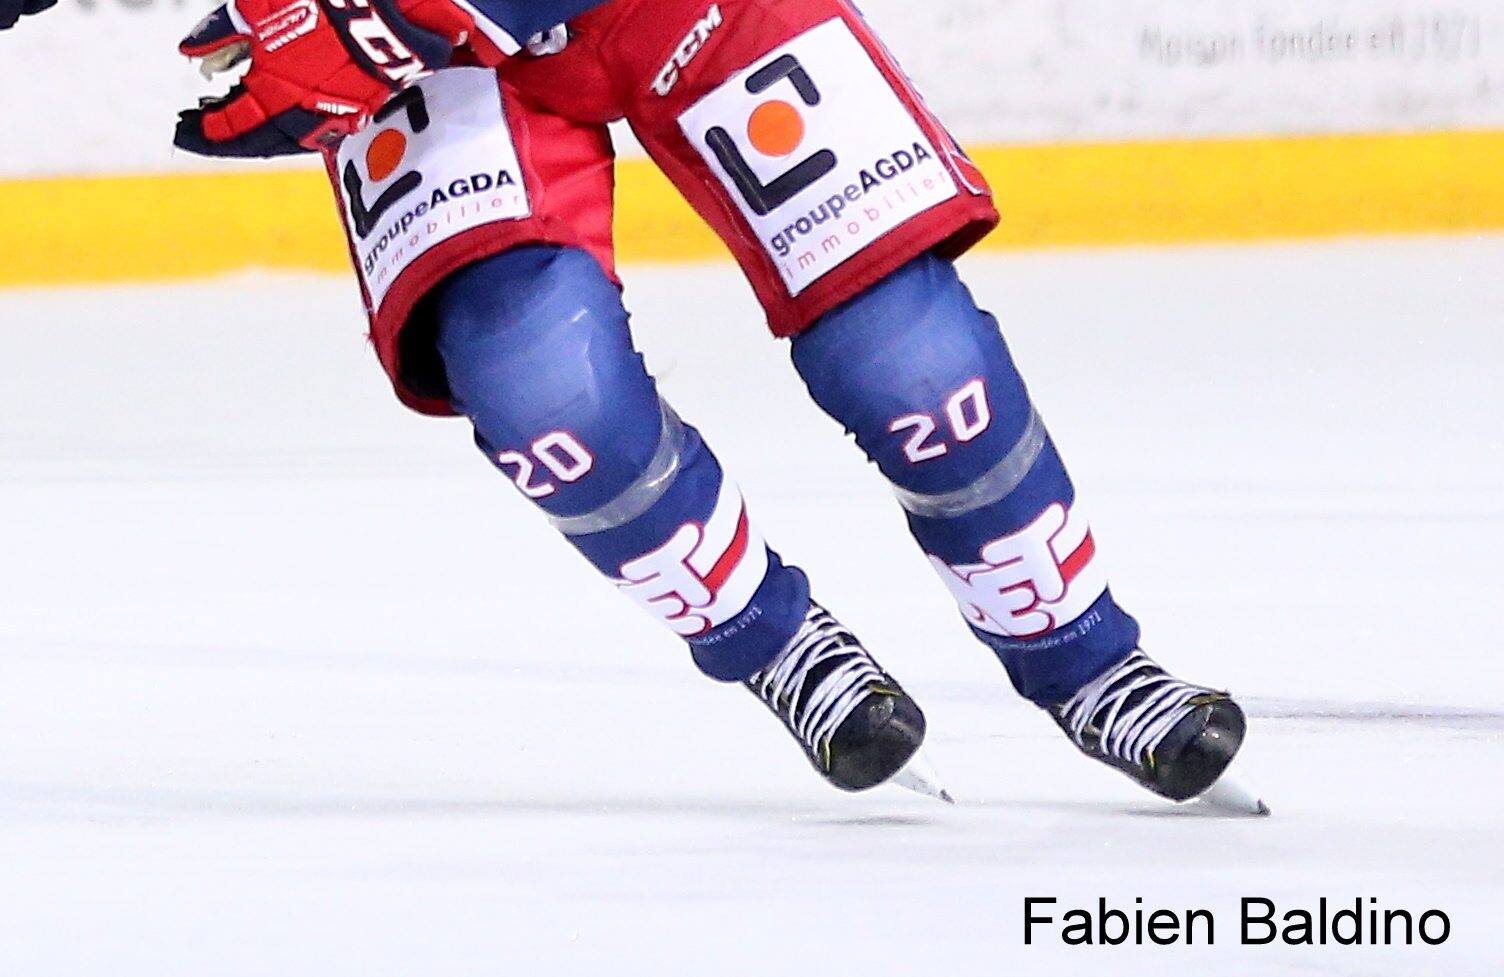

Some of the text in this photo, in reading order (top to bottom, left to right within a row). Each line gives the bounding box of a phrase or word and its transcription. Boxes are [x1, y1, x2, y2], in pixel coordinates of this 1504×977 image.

[649, 3, 724, 97] CCM
[364, 169, 516, 276] groupeAGDA
[376, 195, 521, 284] mmobilier
[770, 141, 933, 257] groupeAGDA
[782, 170, 946, 279] immobilier
[498, 430, 594, 498] 20
[889, 377, 993, 463] 20
